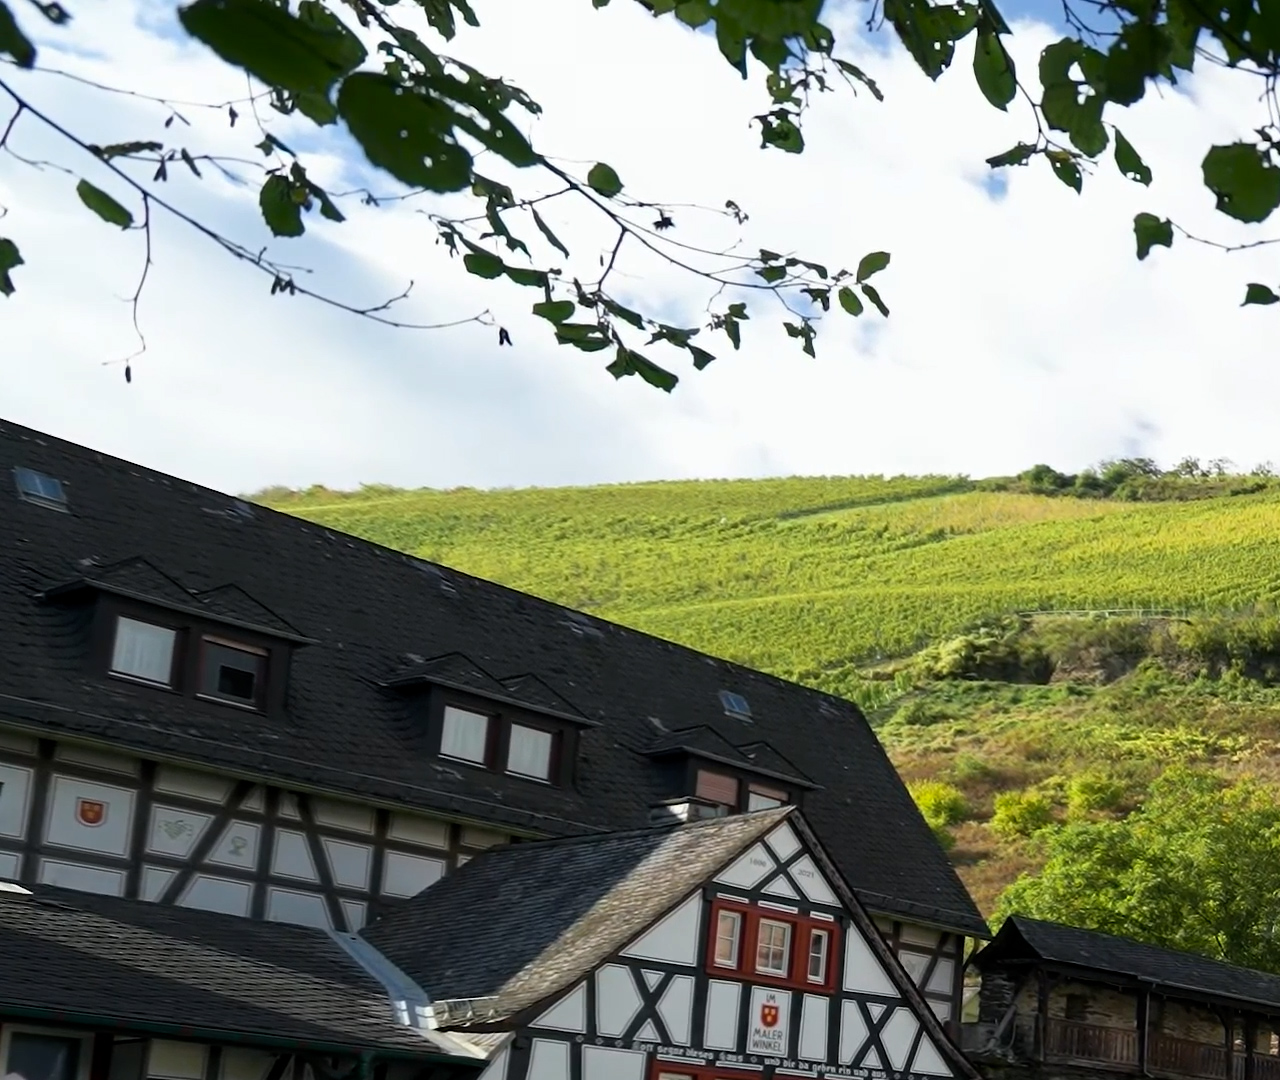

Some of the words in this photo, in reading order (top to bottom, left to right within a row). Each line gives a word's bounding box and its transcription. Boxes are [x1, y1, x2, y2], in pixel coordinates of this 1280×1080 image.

[753, 1028, 783, 1040] MALER
[752, 1039, 782, 1052] WINKEL
[764, 1058, 780, 1066] und
[783, 1059, 796, 1068] die
[798, 1060, 809, 1070] da
[812, 1062, 836, 1074] gehen
[838, 1065, 851, 1075] ein
[853, 1067, 869, 1077] und
